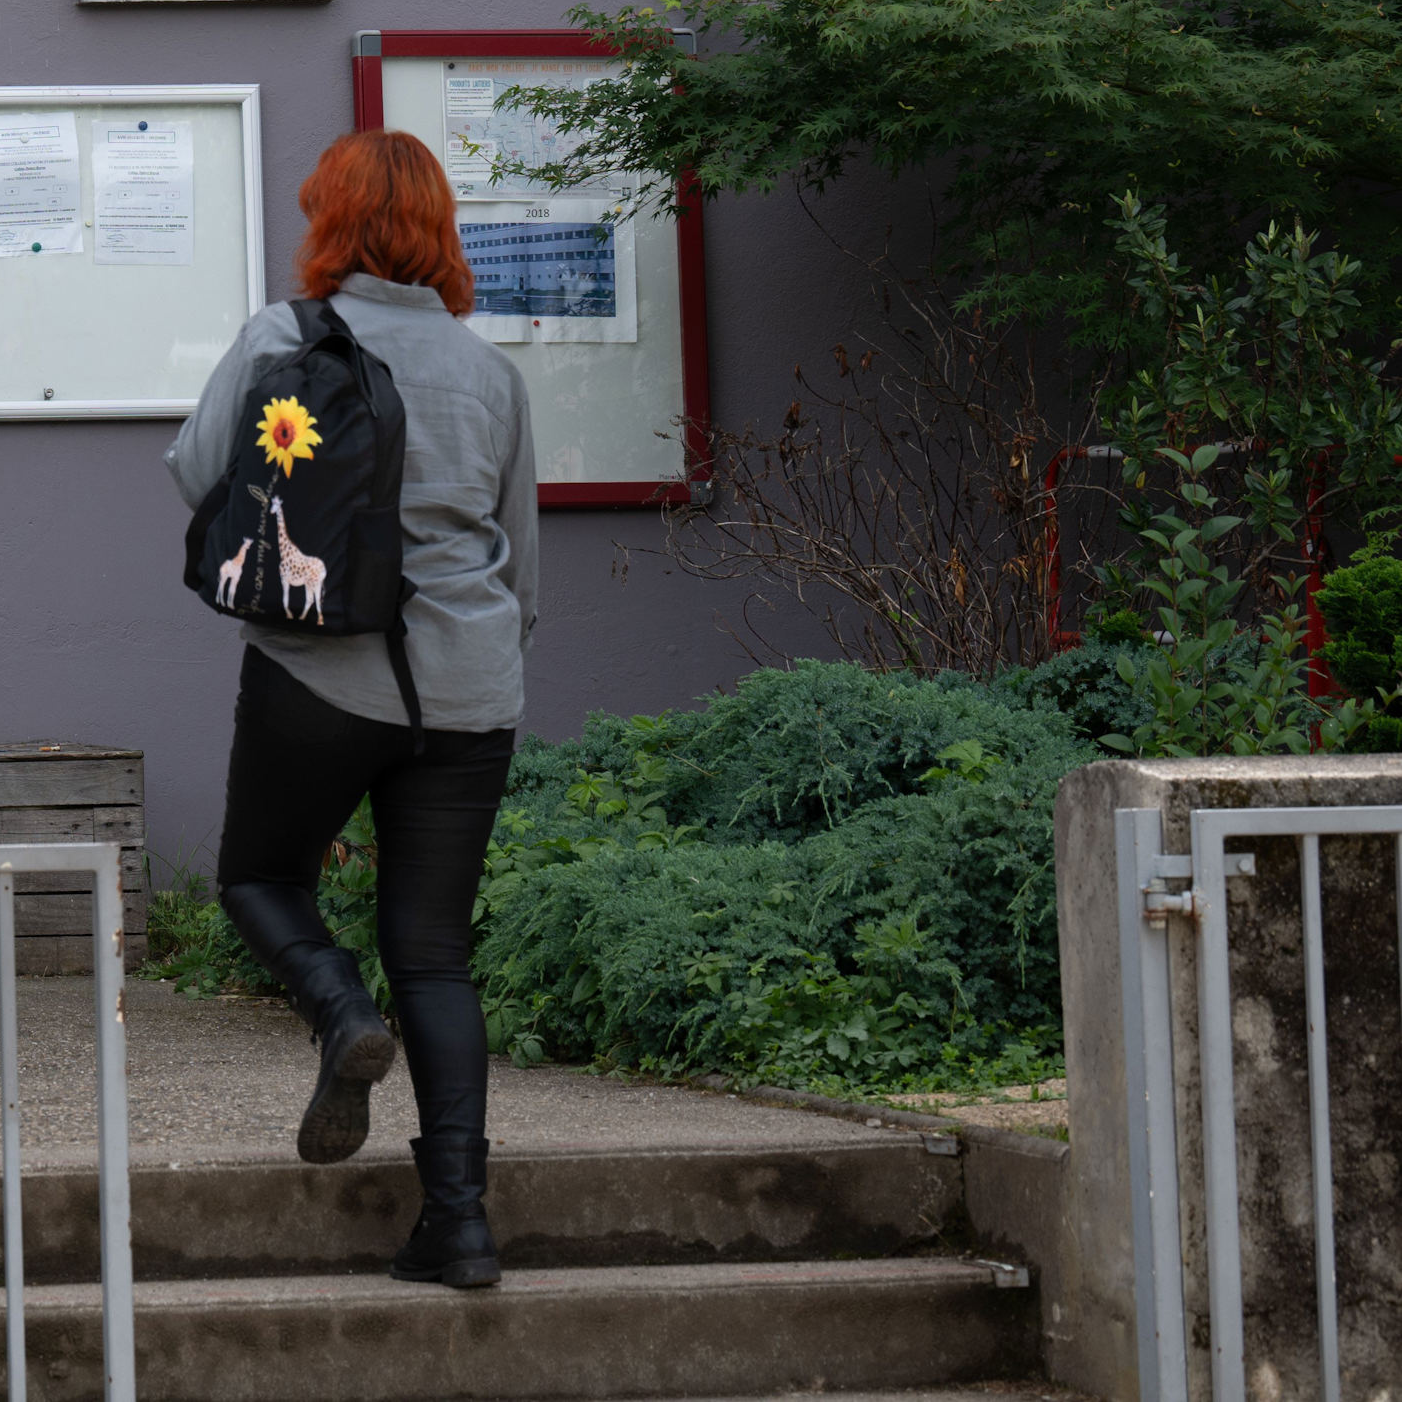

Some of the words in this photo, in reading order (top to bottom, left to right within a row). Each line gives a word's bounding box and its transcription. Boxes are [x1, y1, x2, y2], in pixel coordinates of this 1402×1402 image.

[525, 208, 550, 218] 2018
[256, 538, 273, 564] my
[253, 567, 265, 591] are
